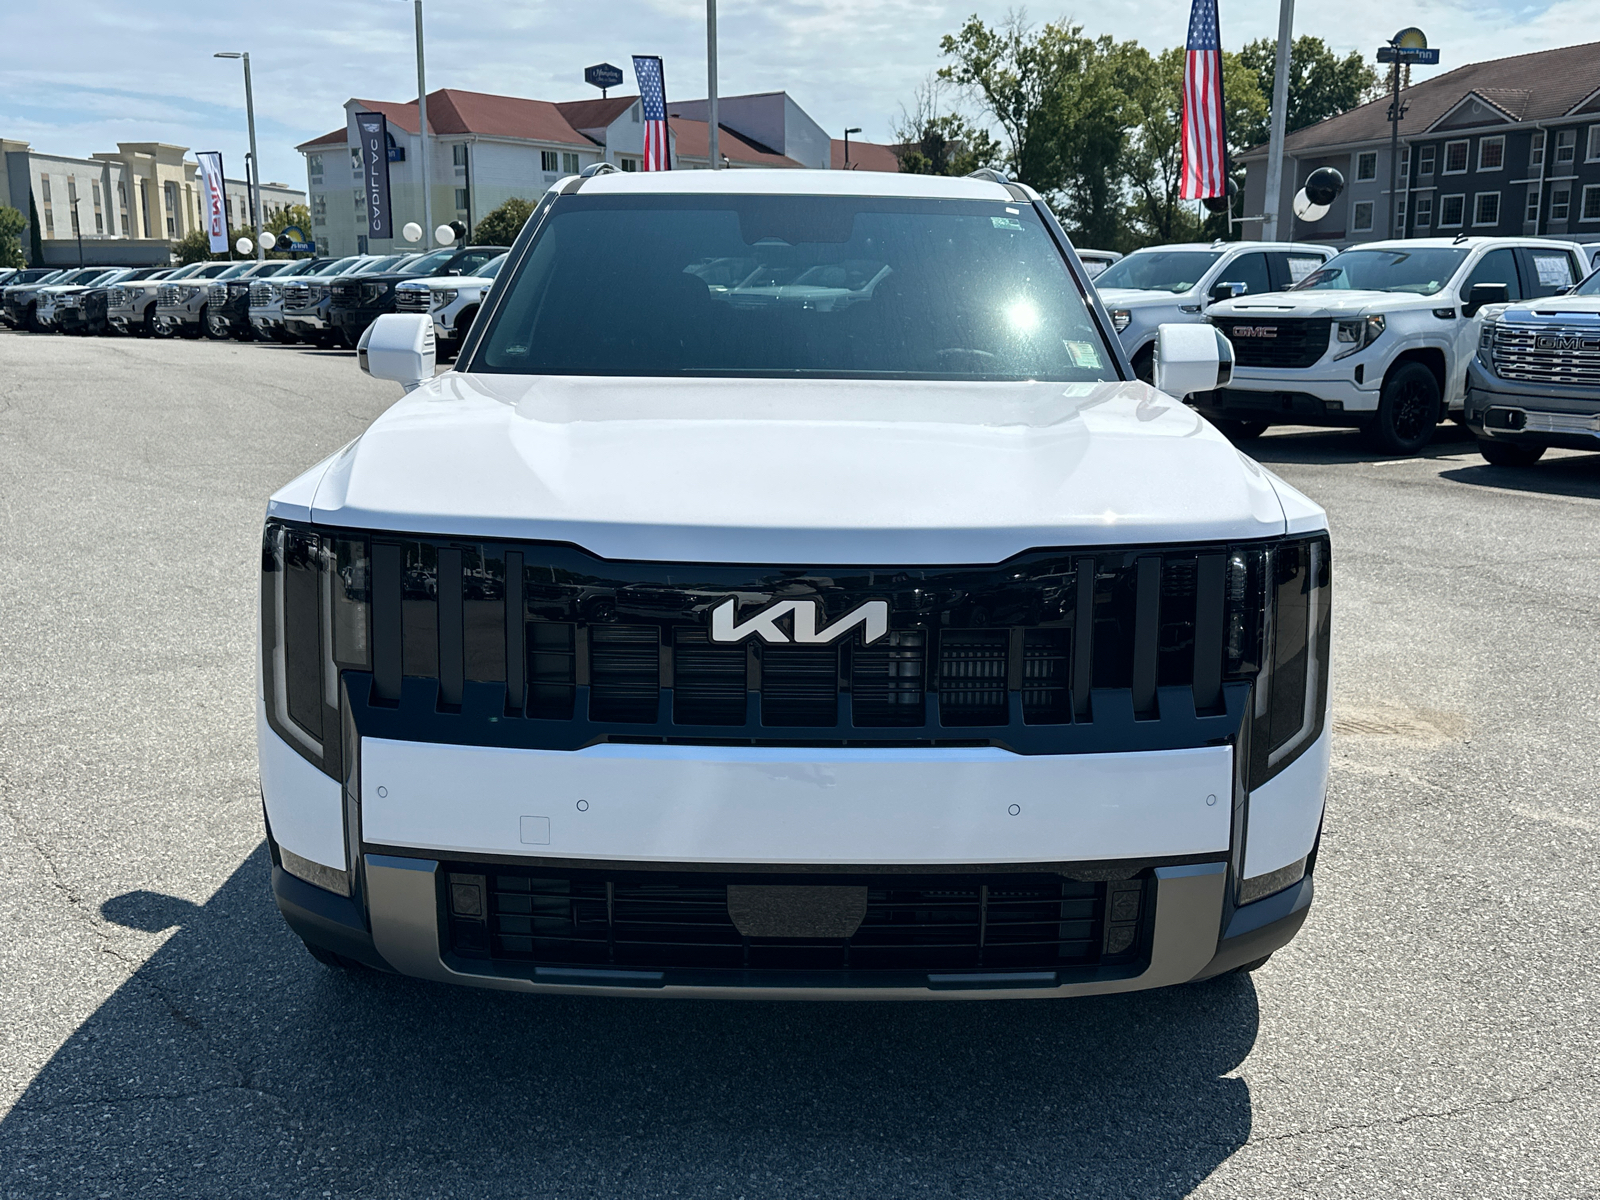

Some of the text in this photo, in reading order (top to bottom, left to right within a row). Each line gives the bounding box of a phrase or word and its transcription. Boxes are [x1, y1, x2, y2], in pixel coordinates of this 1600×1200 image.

[1232, 326, 1278, 338] GMC
[1537, 336, 1600, 350] GMC
[712, 598, 888, 645] KIA
